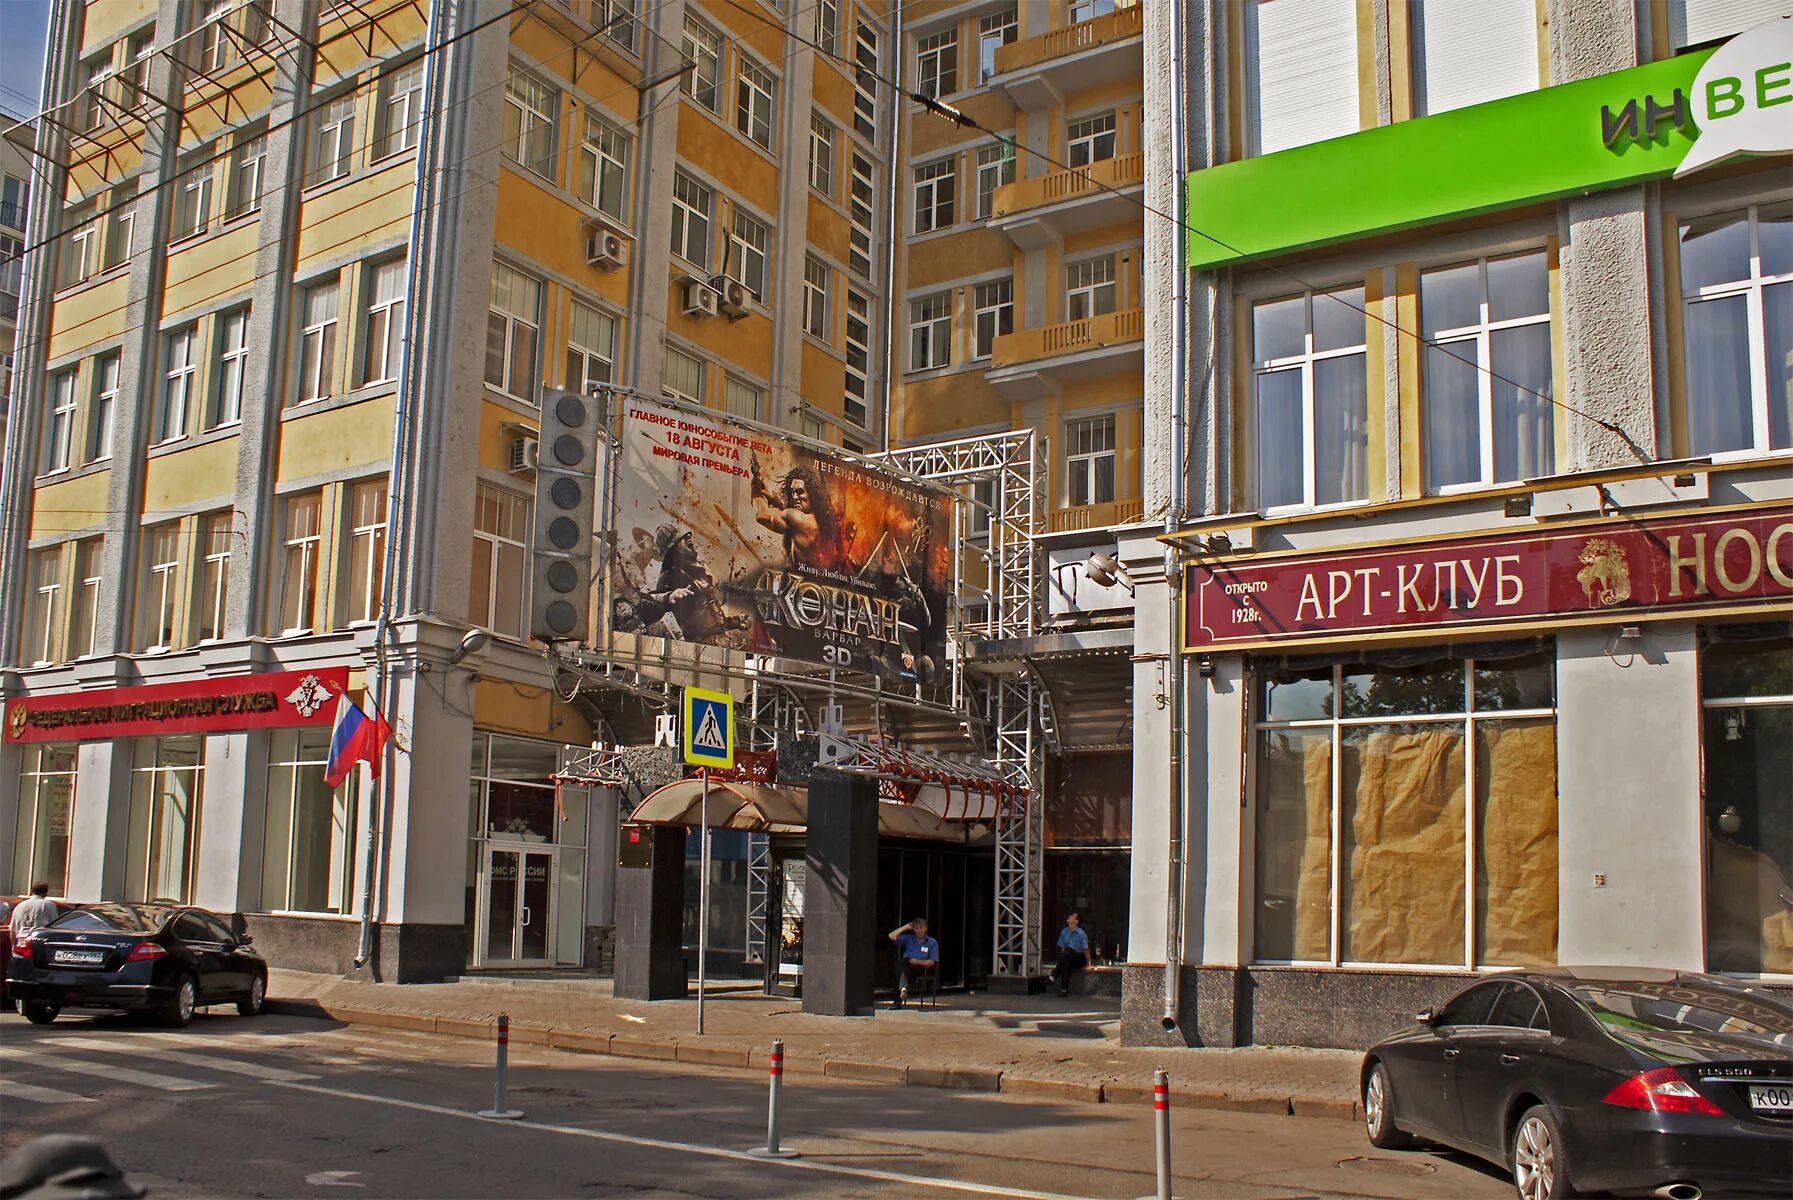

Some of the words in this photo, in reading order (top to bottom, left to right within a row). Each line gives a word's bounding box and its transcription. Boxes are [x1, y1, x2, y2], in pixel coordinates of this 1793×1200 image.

[629, 408, 676, 429] ГЛАВНОЕ
[677, 421, 749, 448] КИНОСОБЫТИЕ
[749, 440, 773, 455] ЛЕТА
[666, 431, 681, 444] 18
[683, 436, 740, 461] АВГУСТА
[652, 445, 700, 466] МИРОВАЯ
[702, 458, 750, 479] ПРЕМЬЕРА
[813, 460, 862, 483] ЛЕГЕНДА
[1225, 581, 1268, 596] ОТКРЫТО
[1295, 555, 1524, 622] АРТ-КЛУБ
[755, 568, 902, 645] КОНАН
[1231, 607, 1262, 623] 1928г.
[814, 628, 861, 646] ВАРВАР
[822, 645, 851, 666] 3D
[216, 691, 278, 714] СЛУЖБА
[1756, 1089, 1793, 1107] К00
